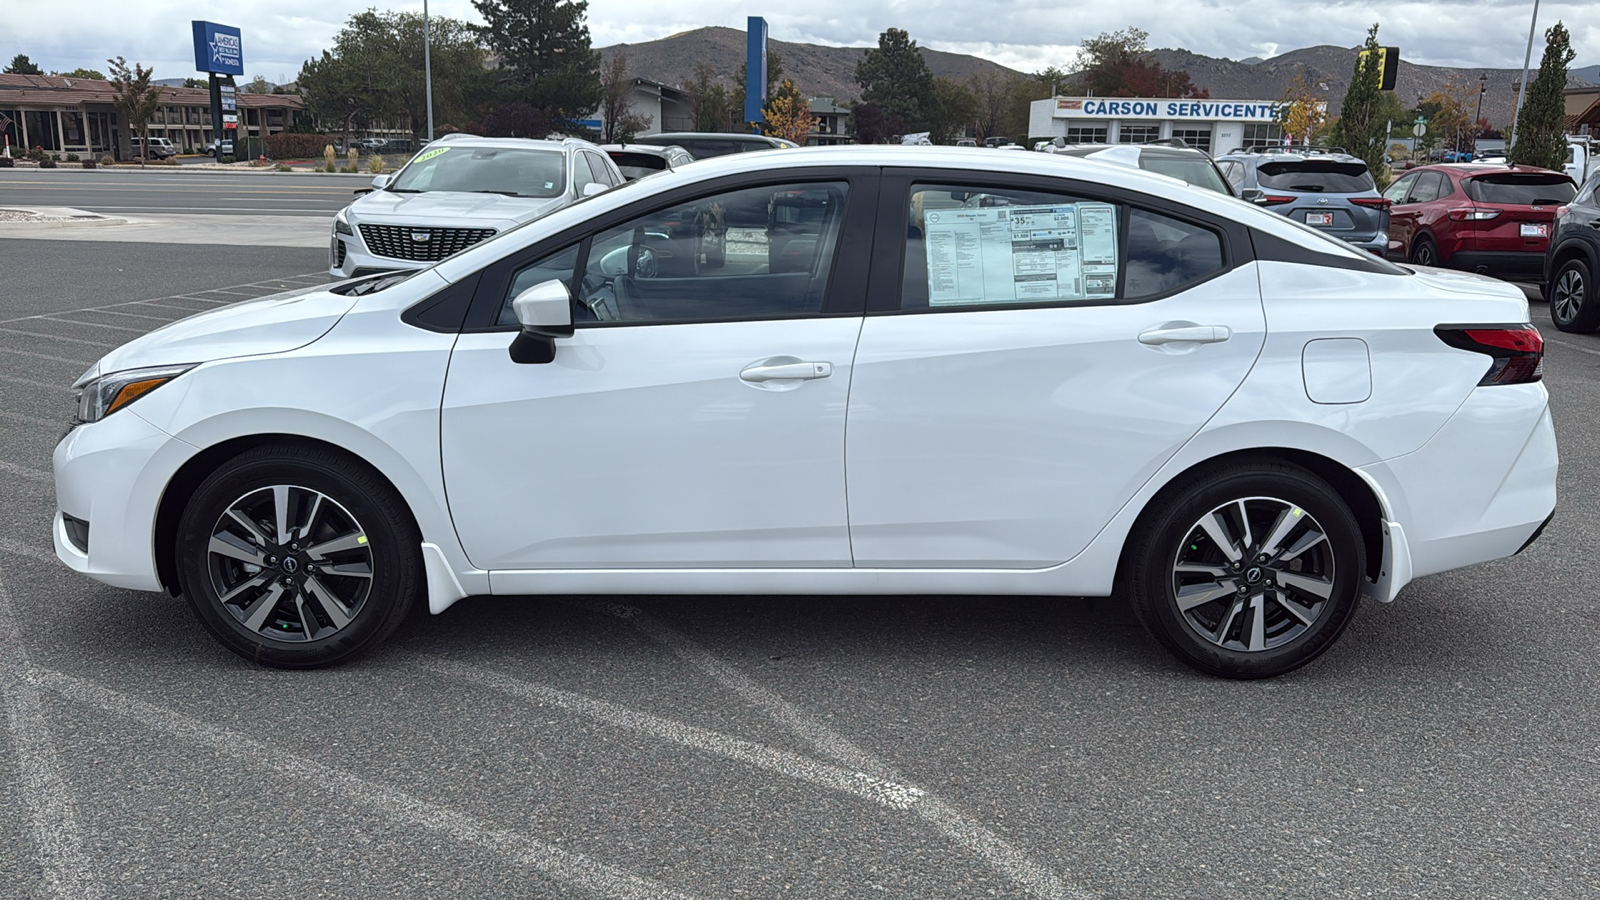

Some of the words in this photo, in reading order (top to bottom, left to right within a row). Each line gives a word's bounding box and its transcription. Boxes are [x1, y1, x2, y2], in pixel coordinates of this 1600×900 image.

[1084, 101, 1158, 116] CARSON
[1167, 102, 1289, 118] SERVICENTE
[421, 148, 445, 160] 2020
[1015, 216, 1026, 225] 35
